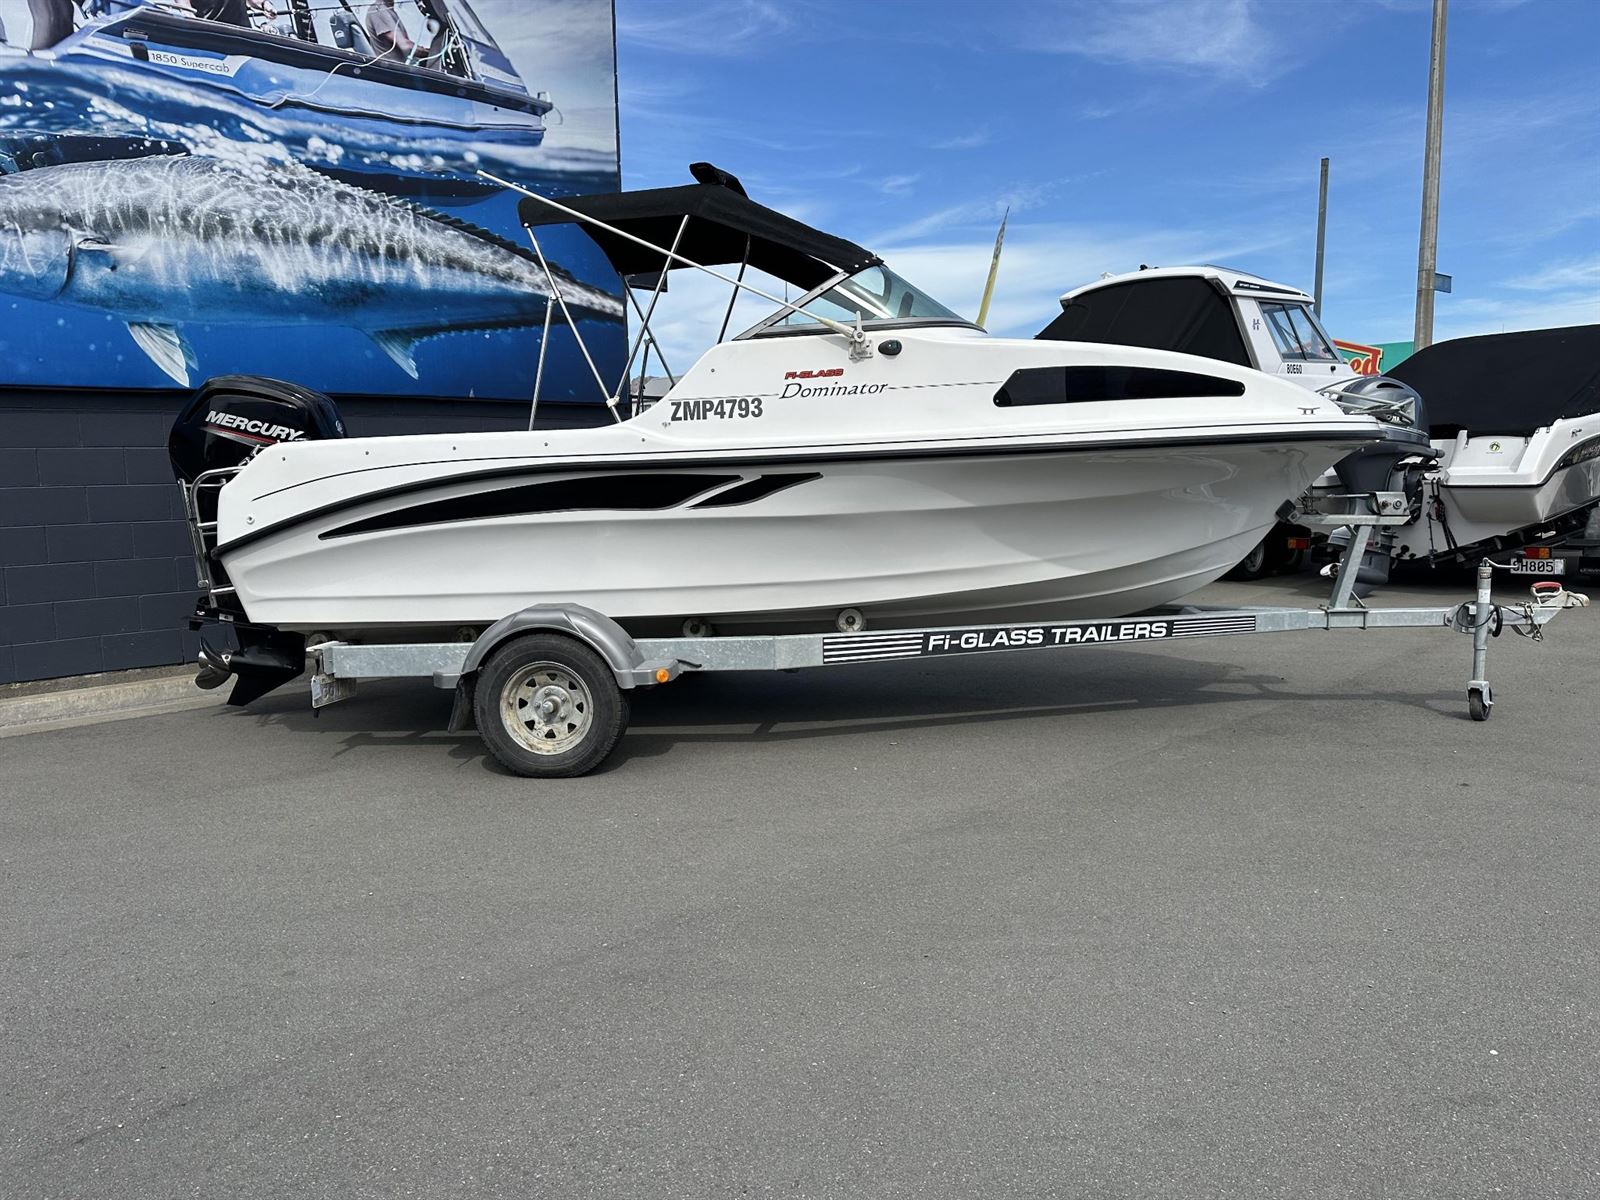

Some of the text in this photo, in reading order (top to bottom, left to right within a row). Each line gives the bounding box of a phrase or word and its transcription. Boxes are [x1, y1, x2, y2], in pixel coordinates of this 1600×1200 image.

[151, 52, 230, 73] 1850 Supercab
[779, 381, 888, 400] Dominator
[670, 397, 764, 422] ZMP4793
[205, 410, 304, 440] MERCURY
[928, 622, 1168, 651] Fi-GLASS TRAILERS
